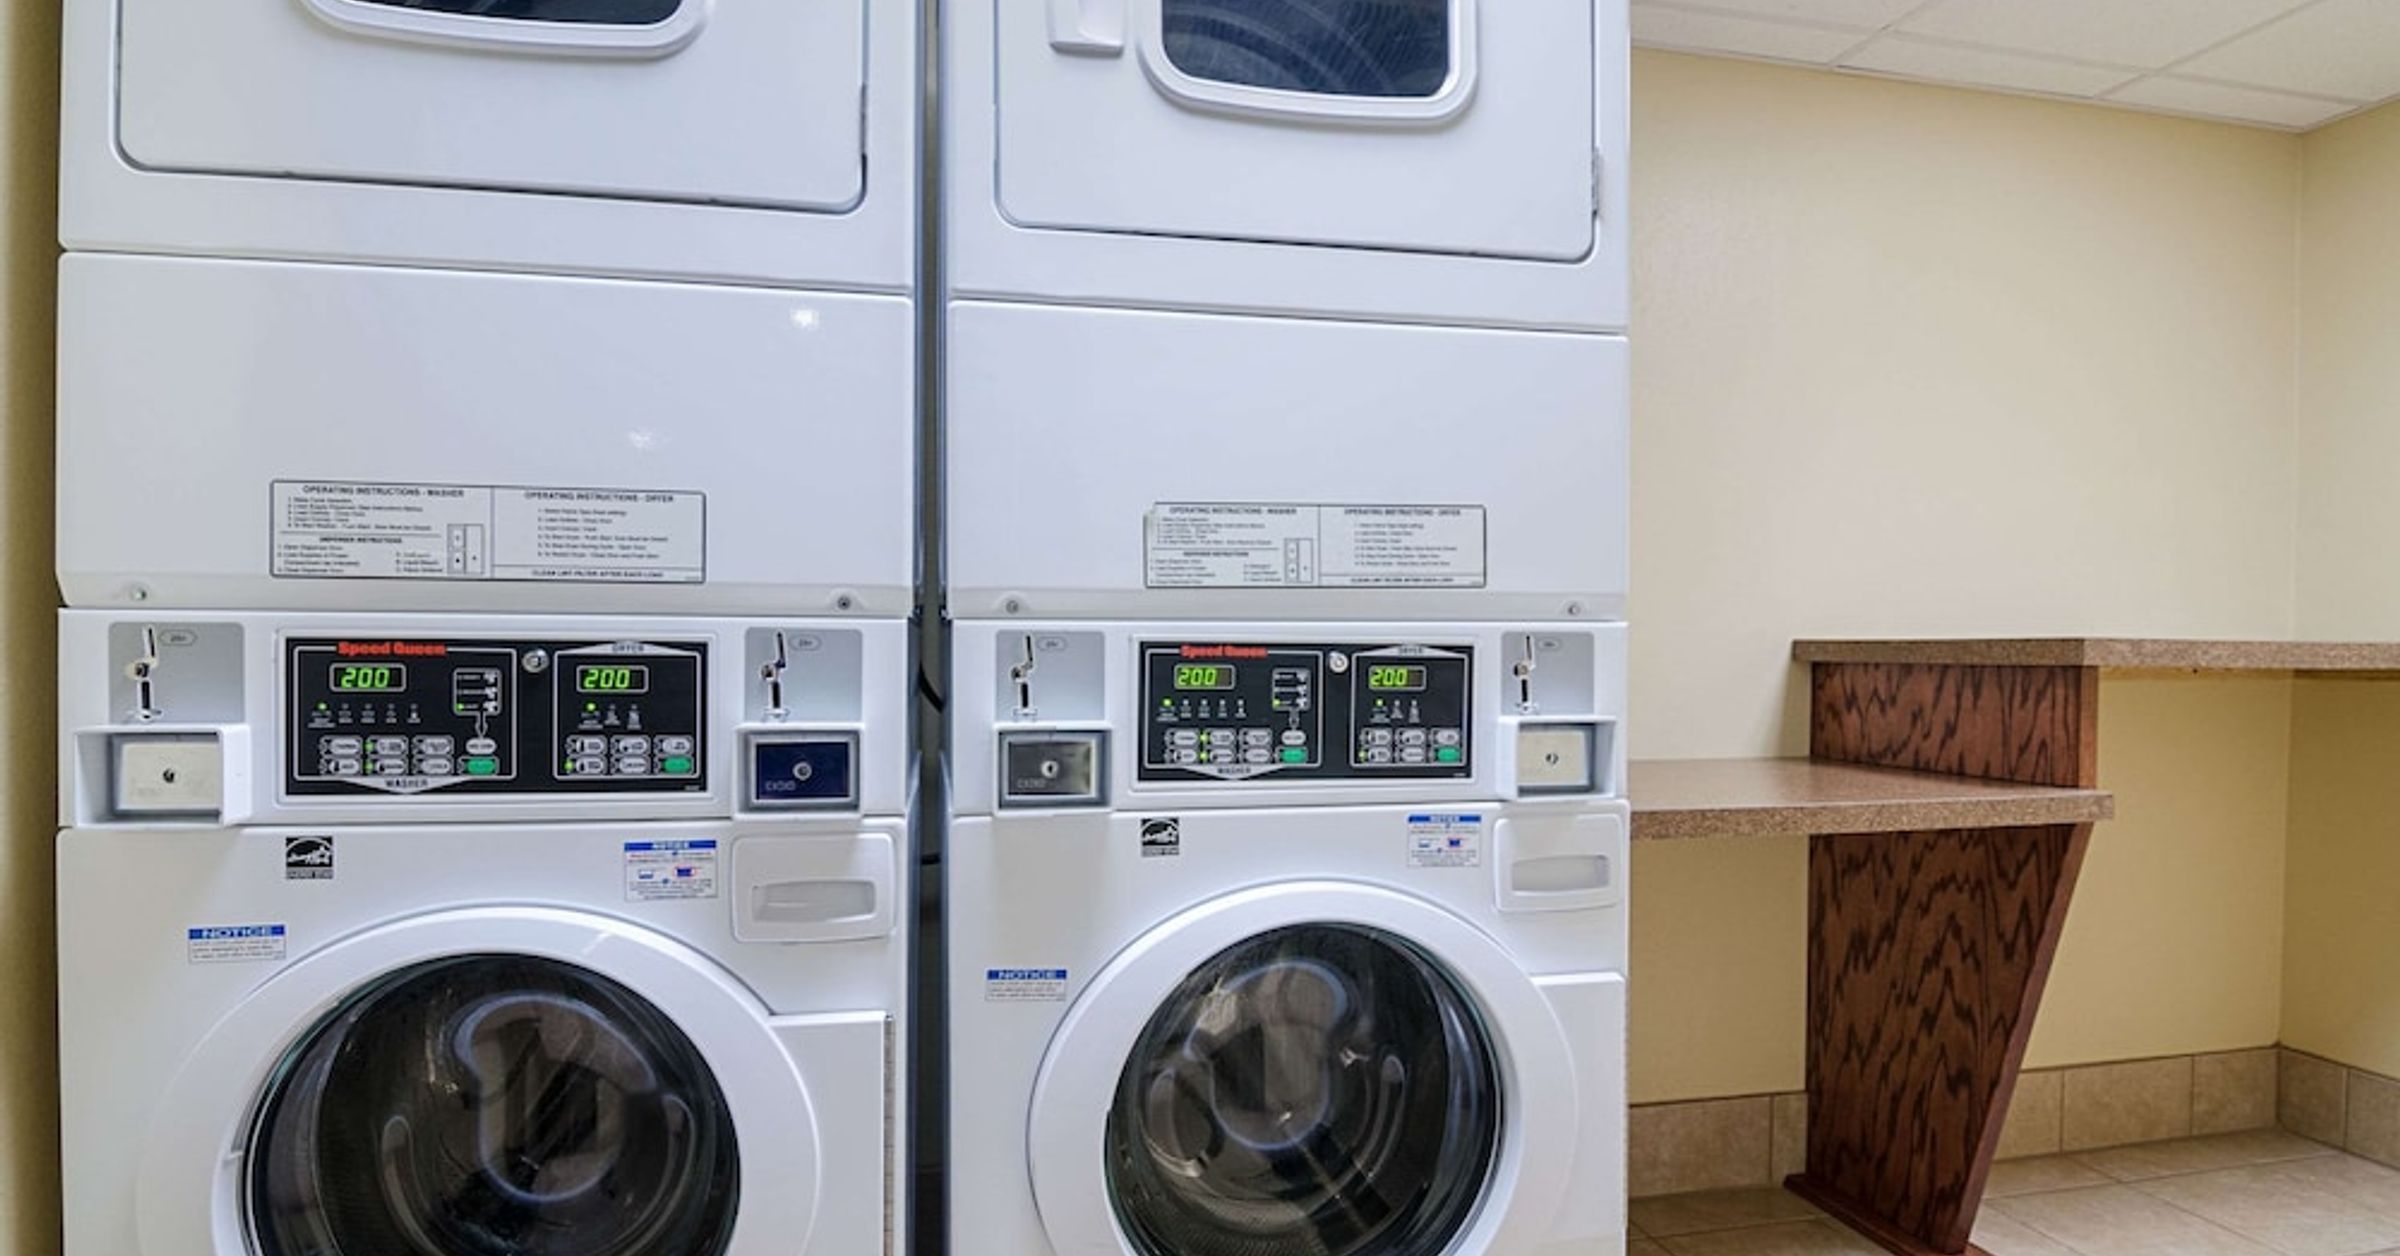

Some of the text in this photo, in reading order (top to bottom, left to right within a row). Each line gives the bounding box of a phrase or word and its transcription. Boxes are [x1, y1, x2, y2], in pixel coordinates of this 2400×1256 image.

[302, 485, 354, 496] OPERATING
[356, 486, 421, 497] INSTRUCTIONS
[427, 488, 465, 498] WASHER
[524, 492, 574, 501] OPERATING
[576, 493, 638, 502] INSTRUCTIONS
[645, 495, 674, 503] DRYER
[338, 642, 447, 656] Speed Queen
[1181, 645, 1268, 658] Speed Queen
[341, 667, 390, 688] 200
[583, 669, 630, 688] 200
[1178, 669, 1217, 686] 200
[1371, 668, 1408, 686] 200
[385, 779, 429, 788] WASHER
[202, 926, 271, 939] NOTICE
[998, 969, 1057, 980] NOTICE
